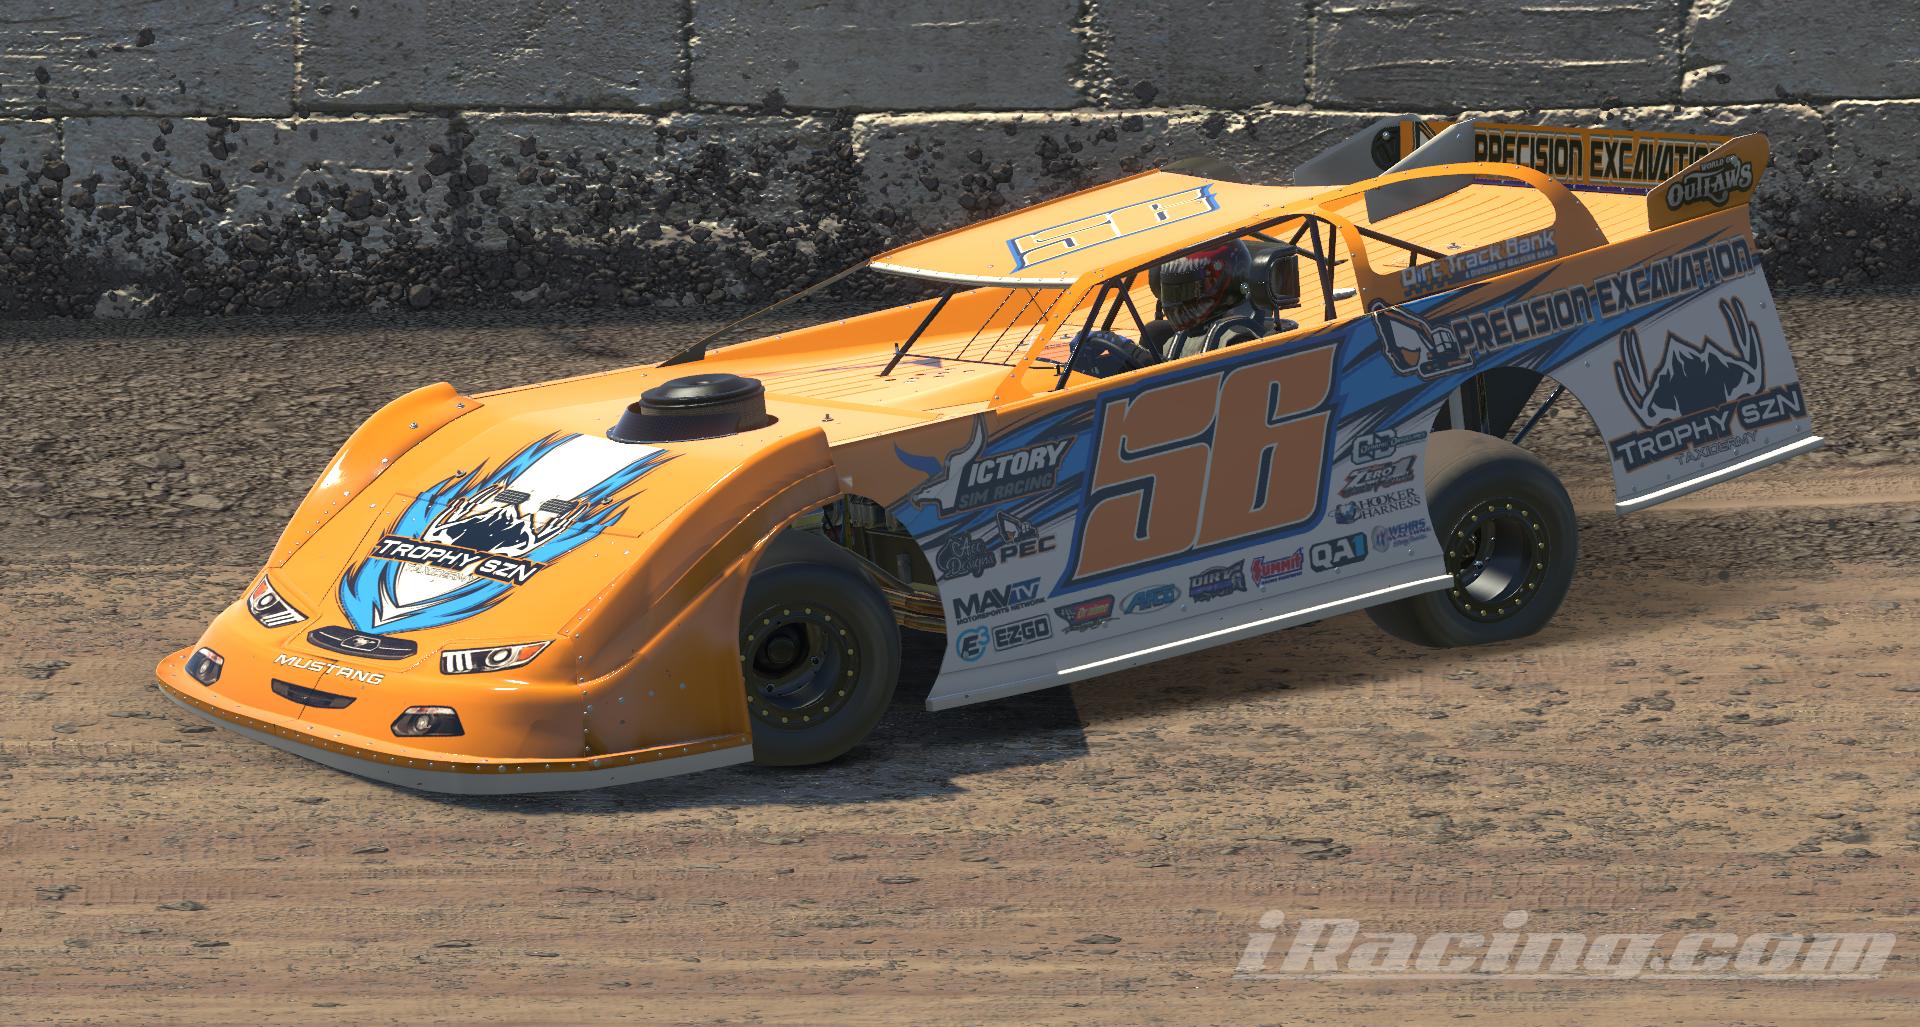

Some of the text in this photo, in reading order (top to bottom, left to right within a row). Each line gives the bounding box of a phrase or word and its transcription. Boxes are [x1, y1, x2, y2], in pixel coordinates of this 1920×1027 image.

[1475, 128, 1583, 180] PRECISION
[1701, 158, 1725, 171] WORLD
[1402, 230, 1555, 287] Dirt Track Bank
[1452, 236, 1755, 356] PRECISION EXCAVATION
[1617, 391, 1800, 464] TROPHY SZN
[1073, 344, 1337, 580] 56
[1674, 430, 1758, 465] TAXIDERMY
[959, 473, 1053, 508] SIM RACING
[1359, 488, 1417, 509] HOOKER
[1361, 497, 1421, 519] HARNESS
[1387, 519, 1426, 535] WEHRS
[378, 539, 538, 583] TROPHY SZN
[1000, 535, 1056, 563] PEC
[1311, 534, 1366, 569] QA1
[952, 576, 1042, 619] MAVTV
[957, 606, 1010, 626] MOTORSPORTS
[274, 653, 385, 685] MUSTANG
